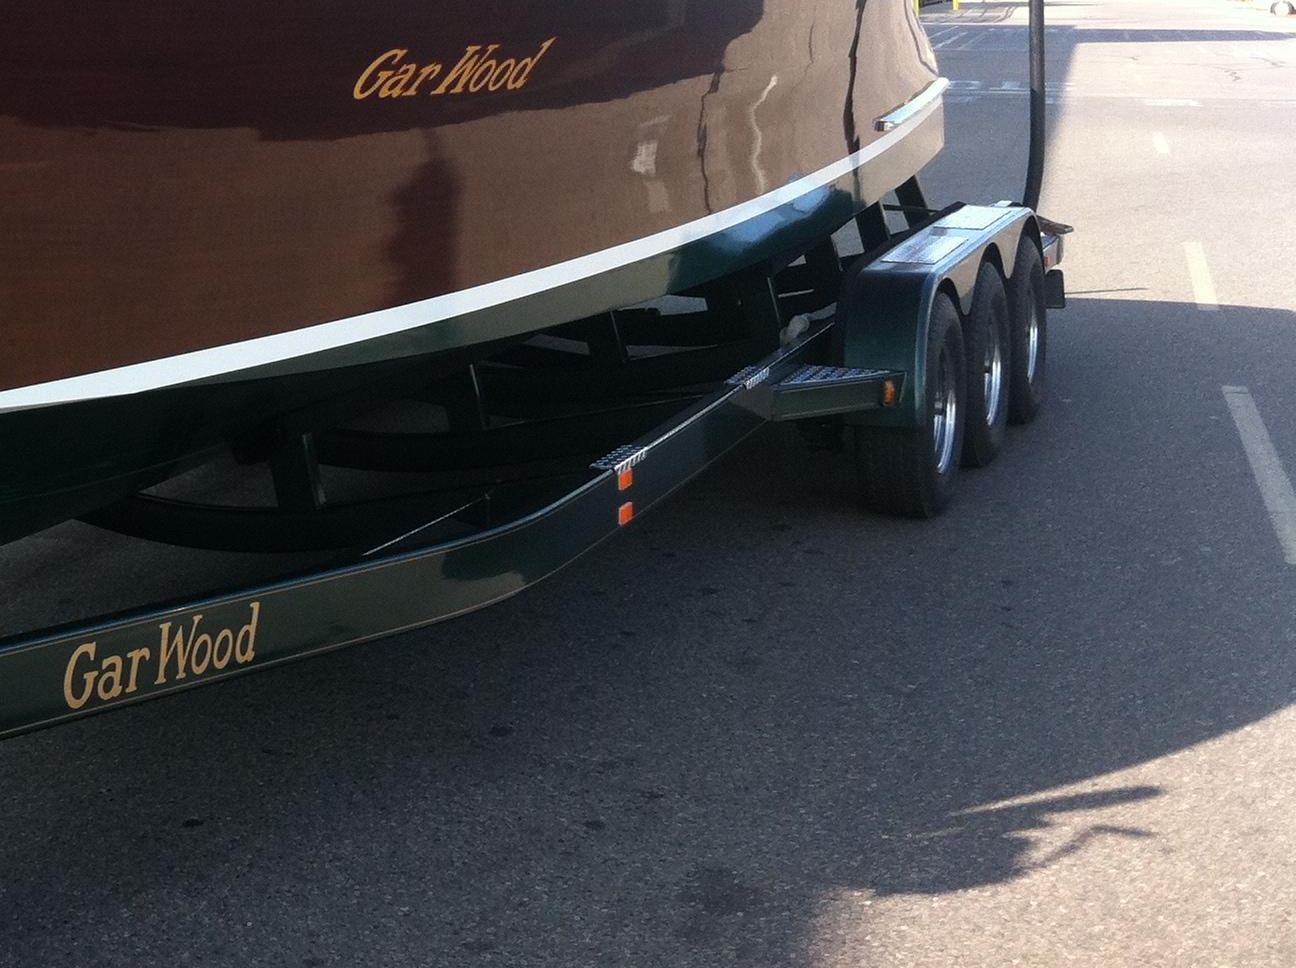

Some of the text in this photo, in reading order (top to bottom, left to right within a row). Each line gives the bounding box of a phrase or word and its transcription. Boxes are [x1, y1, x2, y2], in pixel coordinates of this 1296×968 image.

[353, 36, 557, 100] Gar Wood
[63, 601, 261, 709] Gar Wood
